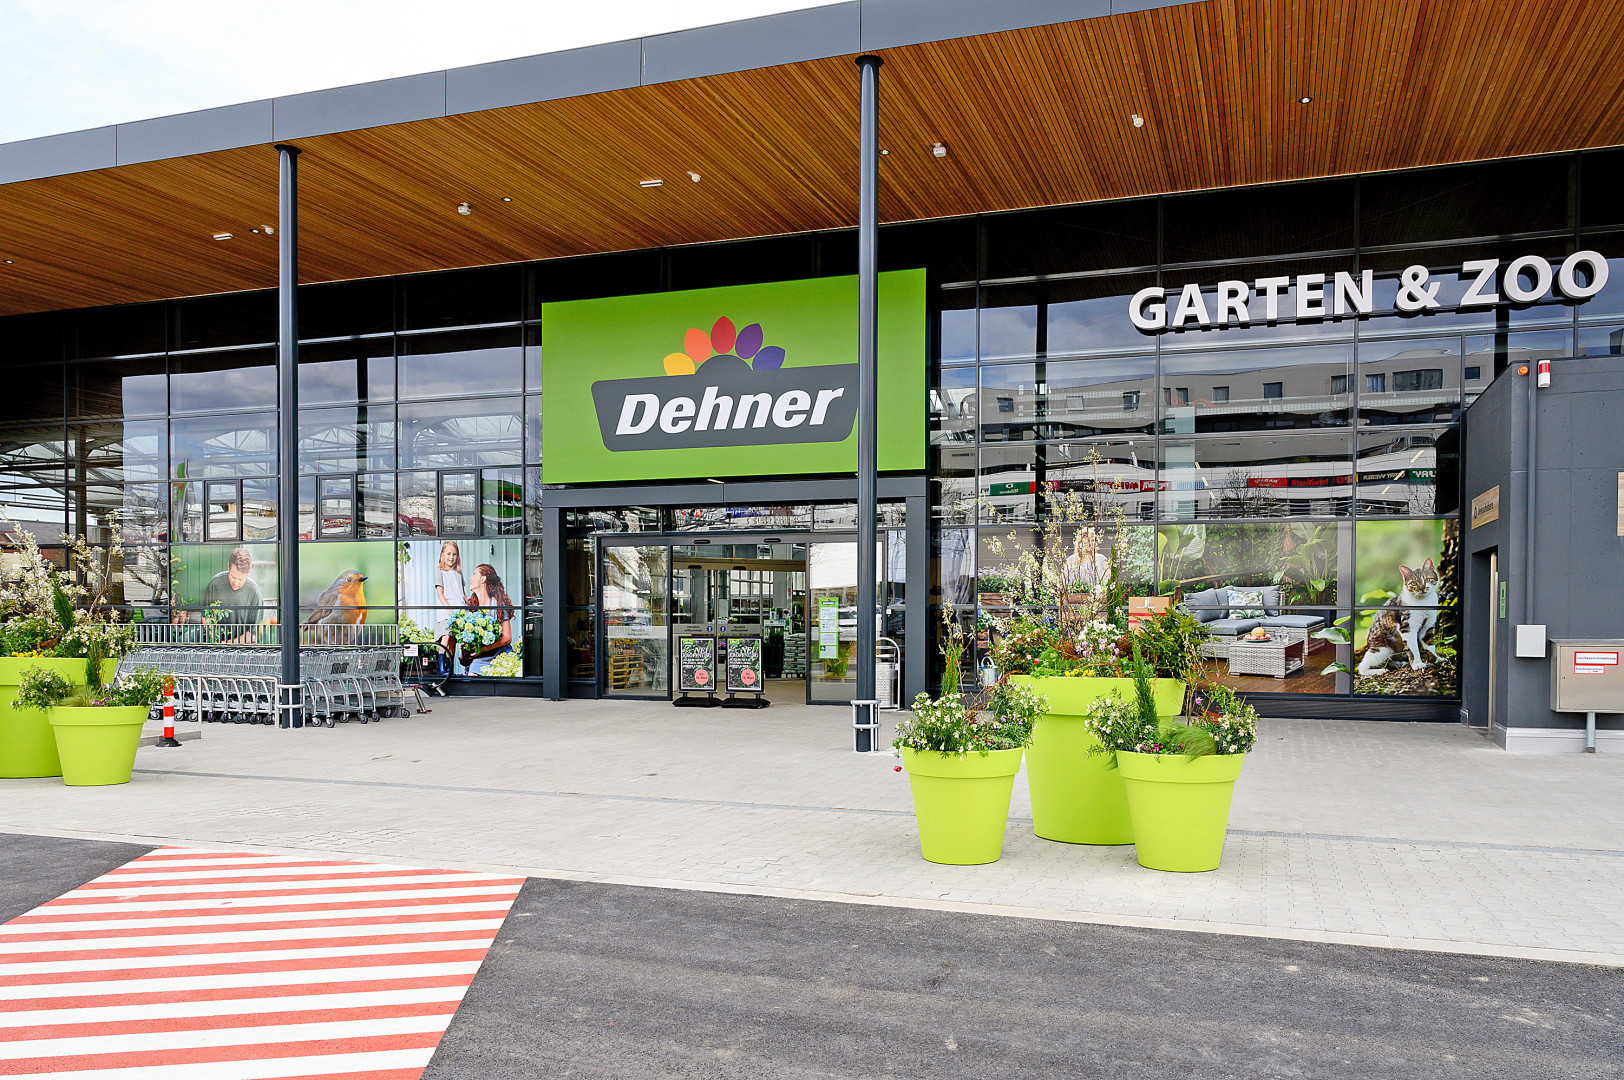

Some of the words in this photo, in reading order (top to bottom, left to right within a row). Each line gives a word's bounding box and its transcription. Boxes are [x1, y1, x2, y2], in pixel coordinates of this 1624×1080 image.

[1127, 269, 1374, 331] GARTEN
[1395, 264, 1441, 312] &
[1459, 250, 1609, 307] ZOO
[615, 385, 845, 436] Dehner
